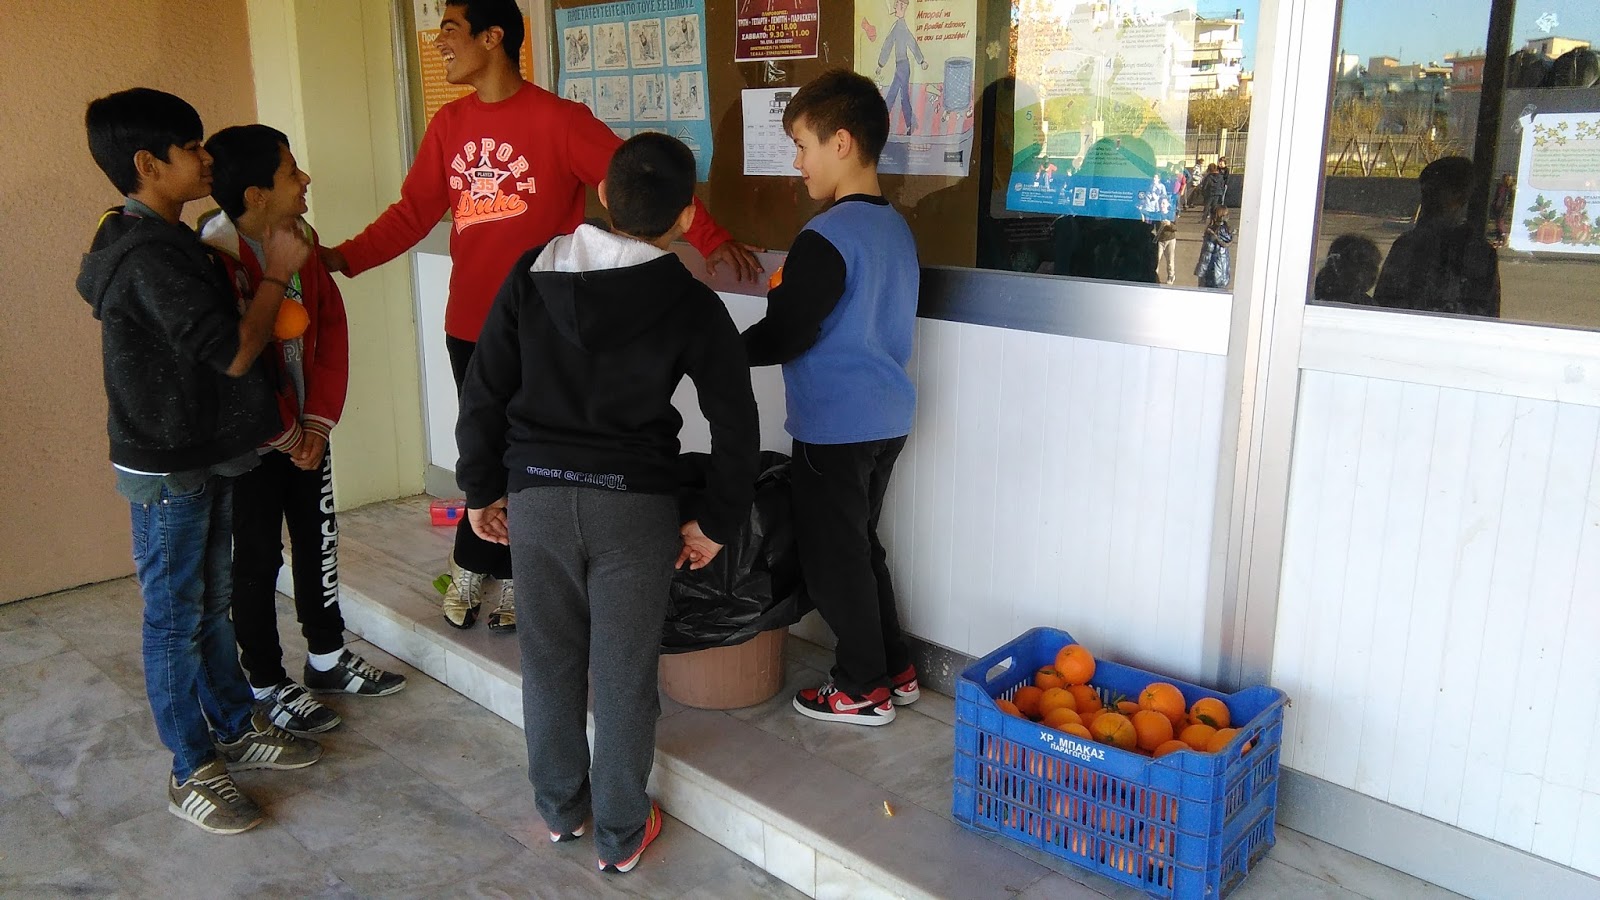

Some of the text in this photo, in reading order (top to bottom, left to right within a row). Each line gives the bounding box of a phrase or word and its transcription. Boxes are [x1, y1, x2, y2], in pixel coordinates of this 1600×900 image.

[620, 5, 636, 16] ΑΠΟ
[636, 2, 656, 14] ΤΟΥΣ
[917, 9, 943, 20] Μπορεί
[742, 32, 768, 40] ΣΑΒΒΑΤΟ:
[449, 138, 536, 194] SUPPORT
[476, 179, 495, 191] 35
[455, 189, 521, 219] Duke
[1040, 731, 1105, 760] ΧΡ. ΜΠΑΚΑΣ
[1050, 743, 1091, 762] ΠΑΡΑΓΩΓΟΣ
